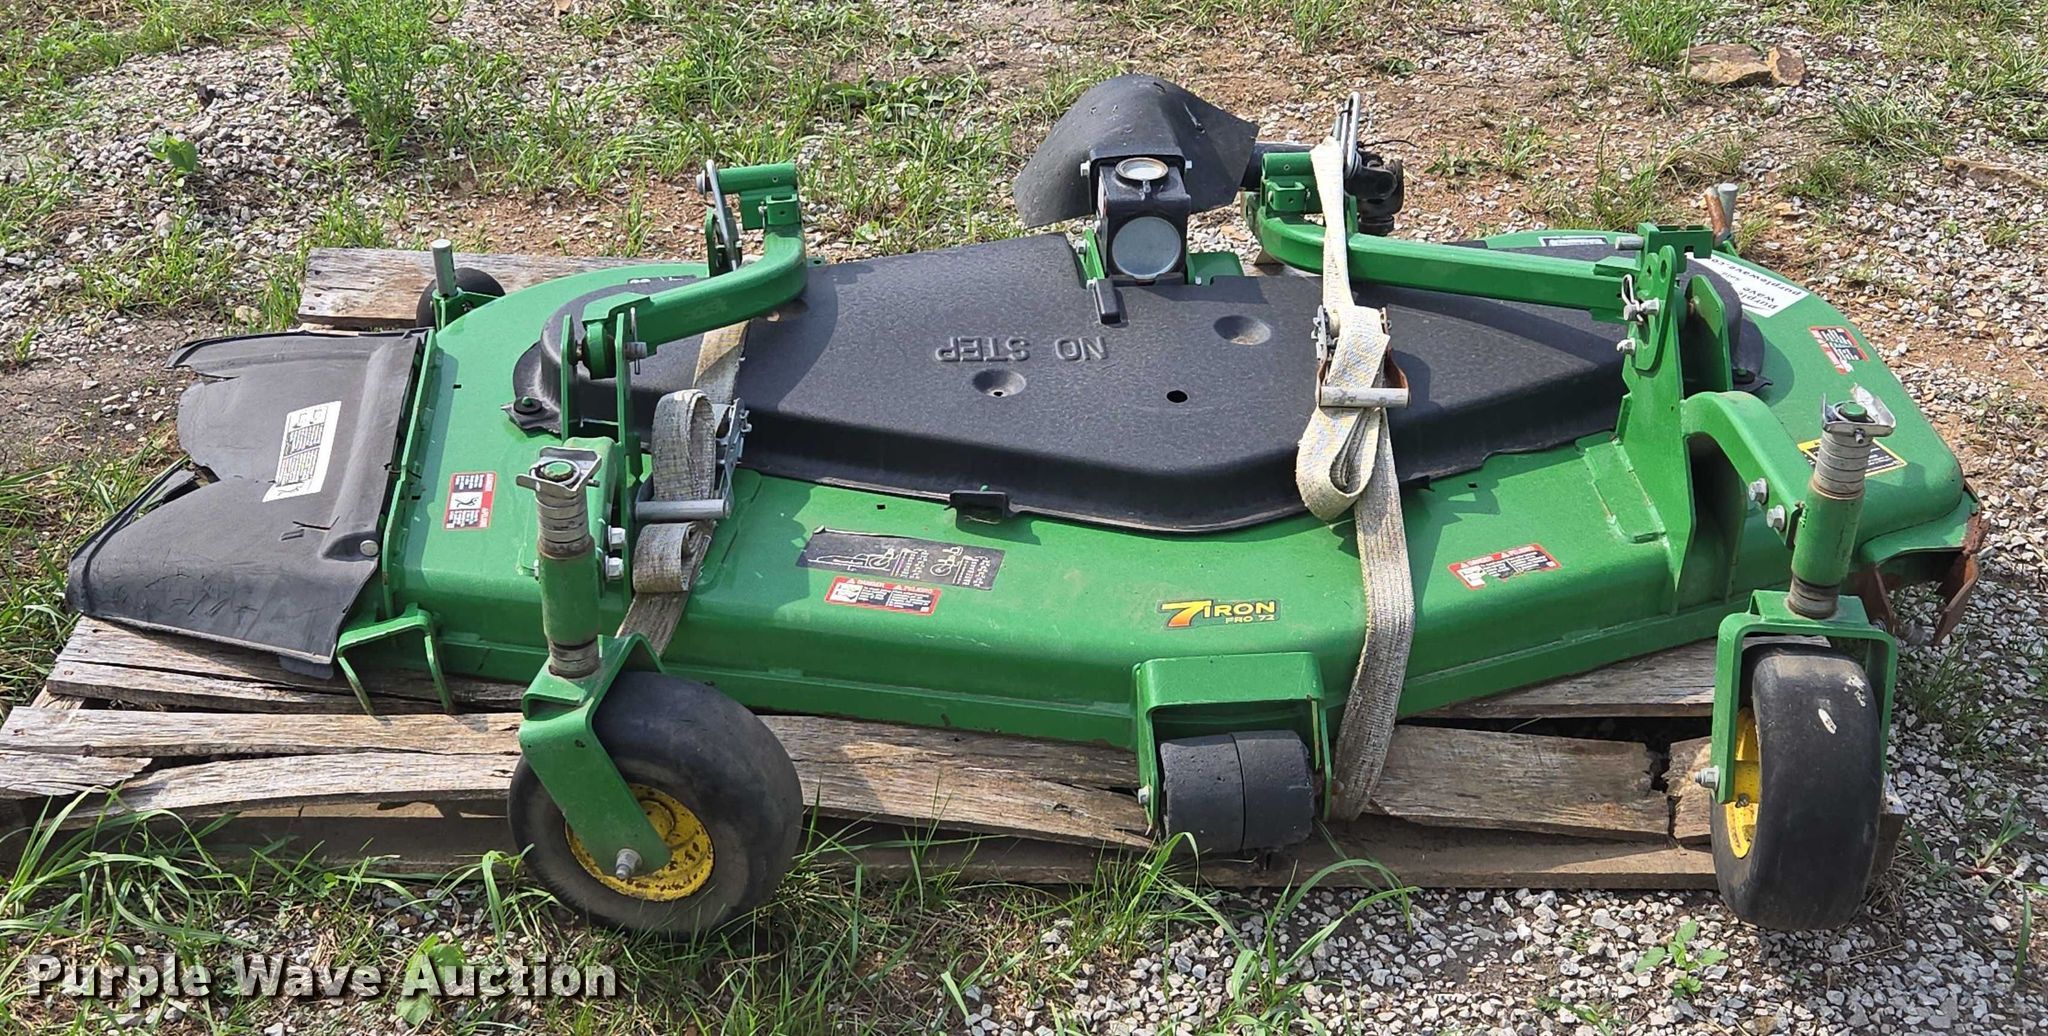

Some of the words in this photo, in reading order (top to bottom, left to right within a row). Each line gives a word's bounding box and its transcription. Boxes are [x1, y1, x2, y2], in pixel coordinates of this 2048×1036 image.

[1711, 258, 1802, 296] purplewave.co
[1738, 291, 1779, 310] purple
[1743, 286, 1775, 302] wave
[934, 336, 1031, 363] STEP
[1054, 336, 1107, 363] NO
[1225, 615, 1254, 625] PRO
[1257, 614, 1276, 622] 72
